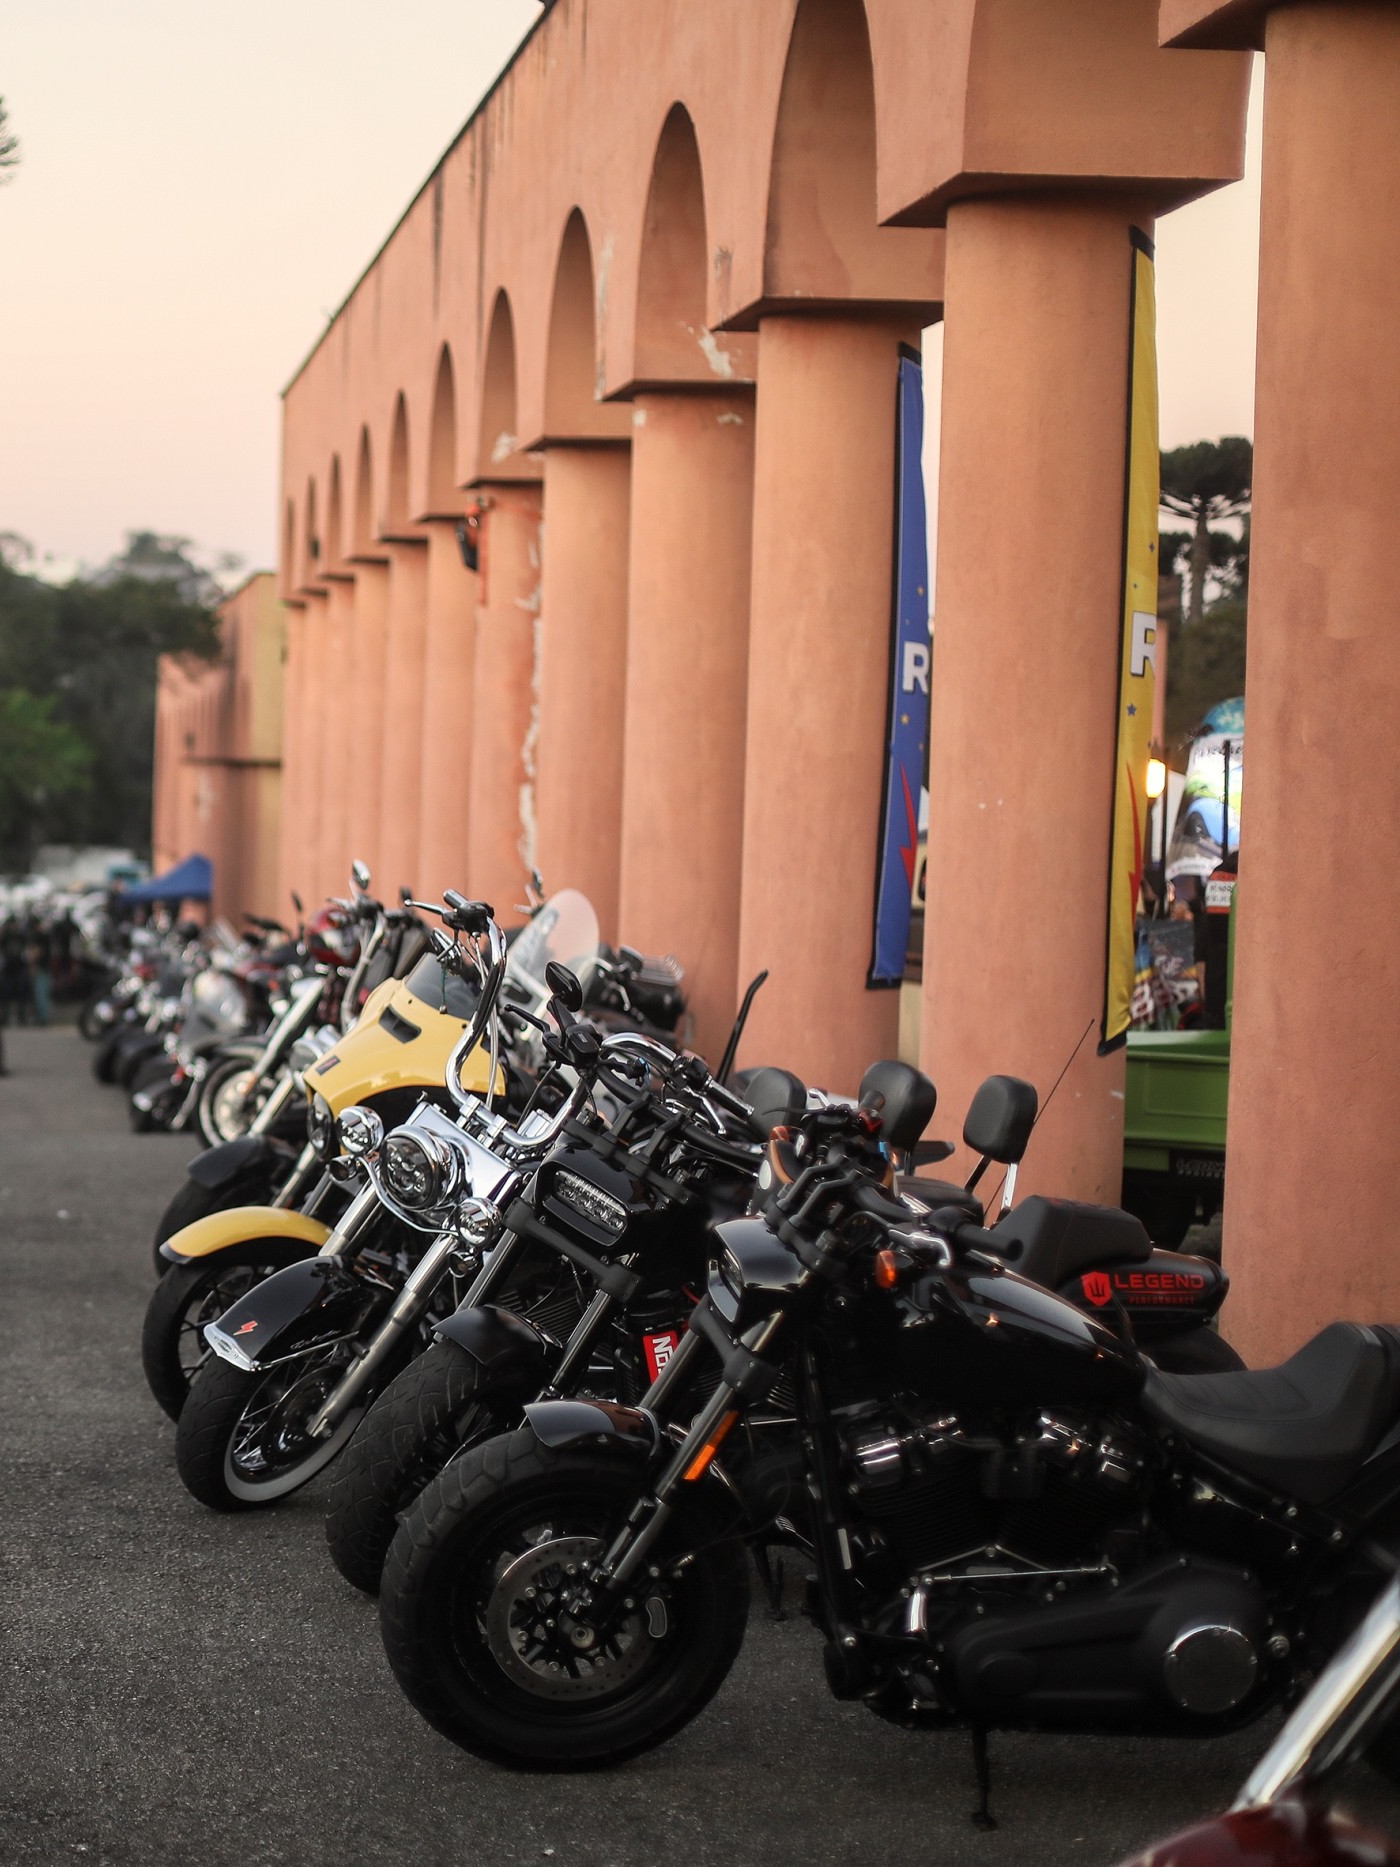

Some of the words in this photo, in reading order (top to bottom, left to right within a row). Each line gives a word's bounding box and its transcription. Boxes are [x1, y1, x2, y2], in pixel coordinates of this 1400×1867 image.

[1114, 1273, 1205, 1289] LEGEND
[1129, 1295, 1195, 1305] PERFORMANCE
[652, 1335, 676, 1376] NO
